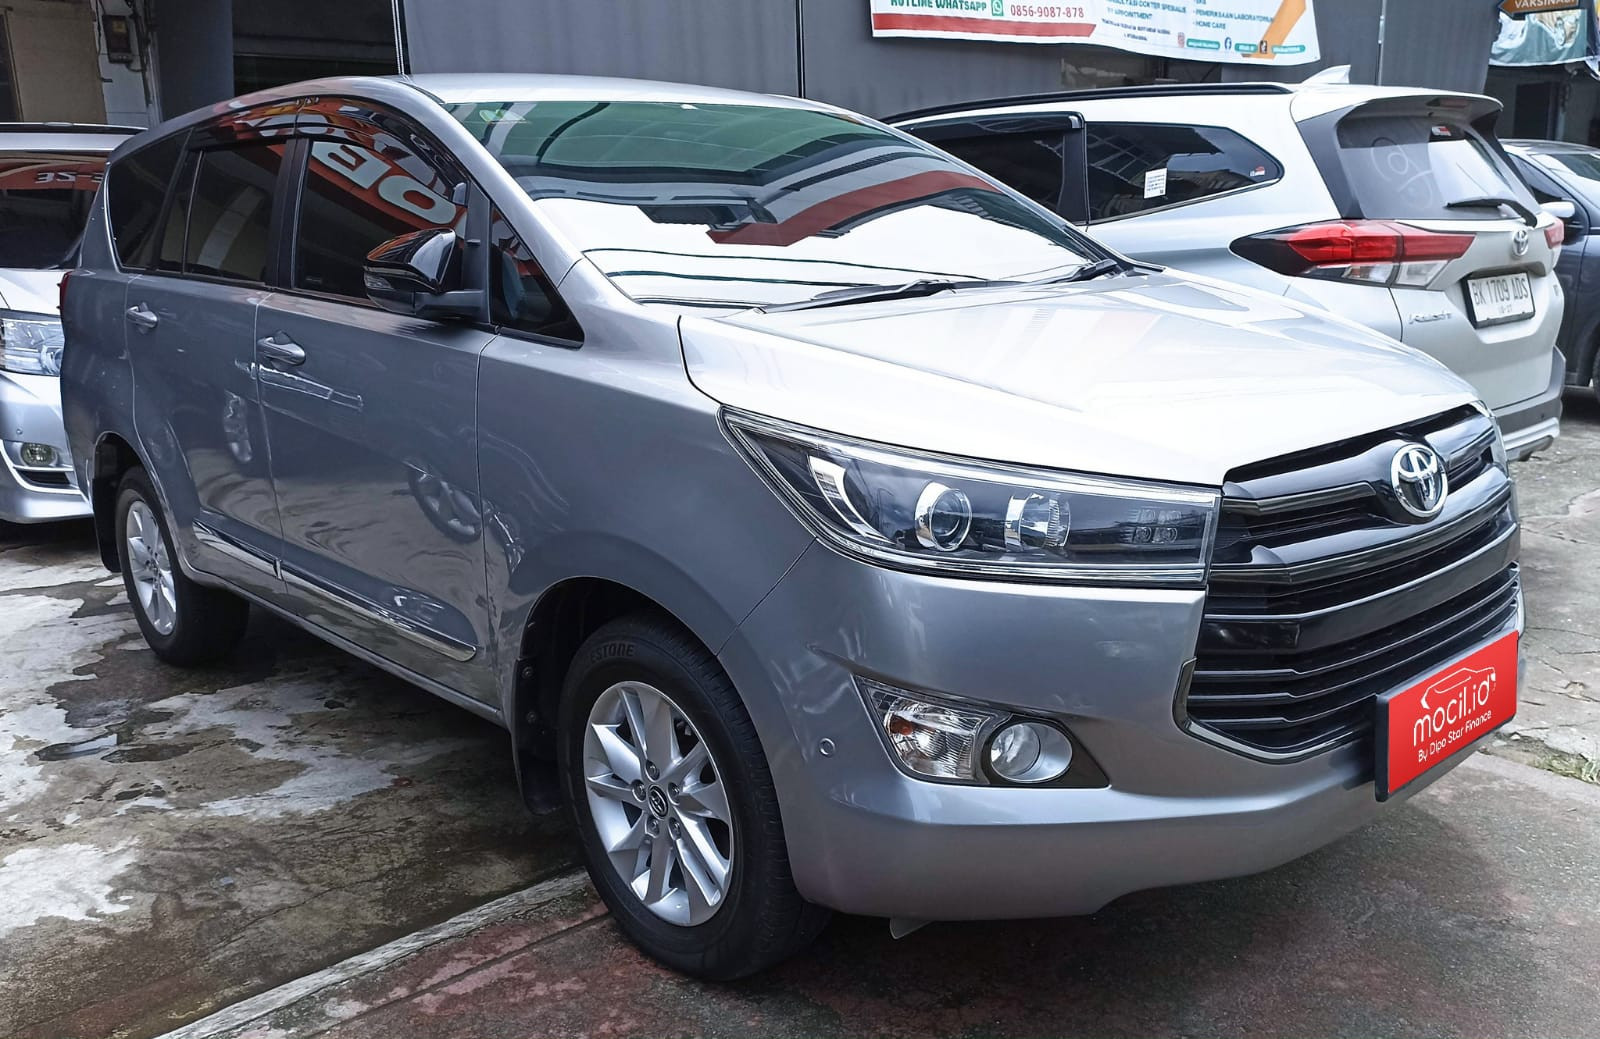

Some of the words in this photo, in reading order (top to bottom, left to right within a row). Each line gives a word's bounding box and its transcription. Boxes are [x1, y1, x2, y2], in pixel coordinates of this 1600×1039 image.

[935, 0, 987, 11] WHATSAPP
[1010, 4, 1084, 18] 0856-9087-878
[1514, 0, 1575, 8] VAKSIN
[1472, 282, 1486, 305] BK
[1486, 279, 1511, 304] 1709
[1511, 277, 1528, 299] ADS
[1413, 674, 1490, 746] mocil.id
[1418, 749, 1428, 763] By
[1429, 740, 1447, 756] Dipo
[1448, 727, 1463, 744] Star
[1465, 710, 1492, 734] Finance
